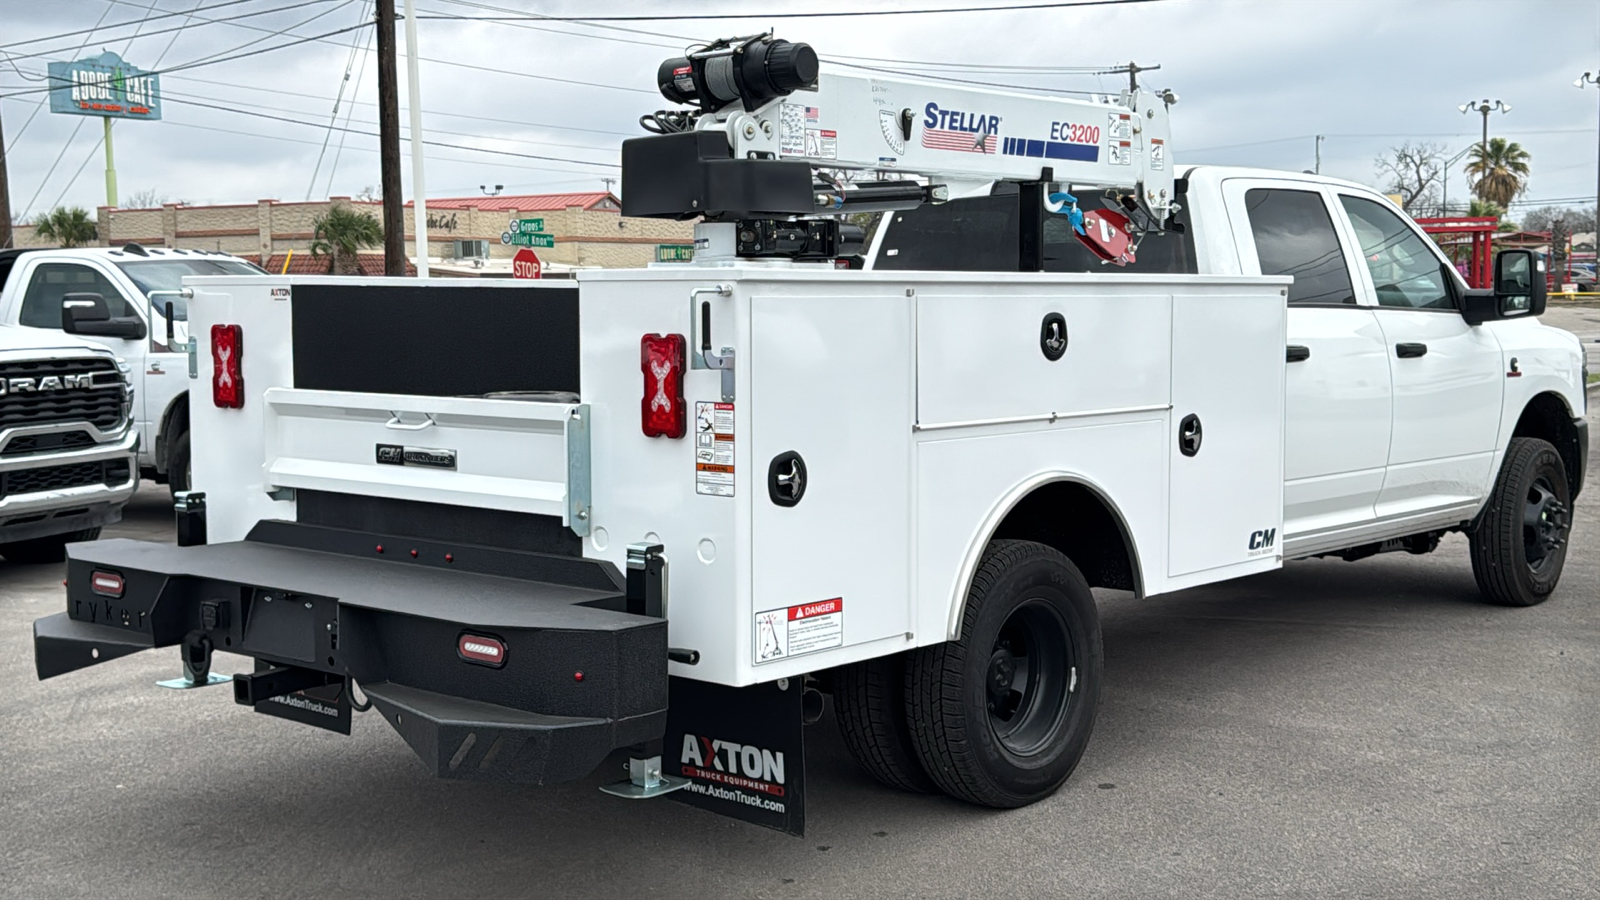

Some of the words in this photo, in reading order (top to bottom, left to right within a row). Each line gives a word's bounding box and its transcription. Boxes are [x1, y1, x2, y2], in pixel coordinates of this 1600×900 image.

[72, 69, 113, 101] ADOBE
[125, 75, 156, 108] CAFE
[923, 101, 999, 135] STELLAR
[1050, 121, 1100, 144] EC3200
[439, 212, 457, 233] Cafe
[512, 233, 530, 245] Elliot
[531, 235, 547, 246] Knox
[515, 261, 539, 279] STOP
[270, 288, 291, 296] AXTON
[9, 374, 91, 393] RAM
[1248, 527, 1277, 550] CM
[804, 602, 835, 616] DANGER
[681, 733, 785, 785] AXTON
[696, 768, 722, 782] TRUCK
[723, 775, 770, 793] EQUIPMENT
